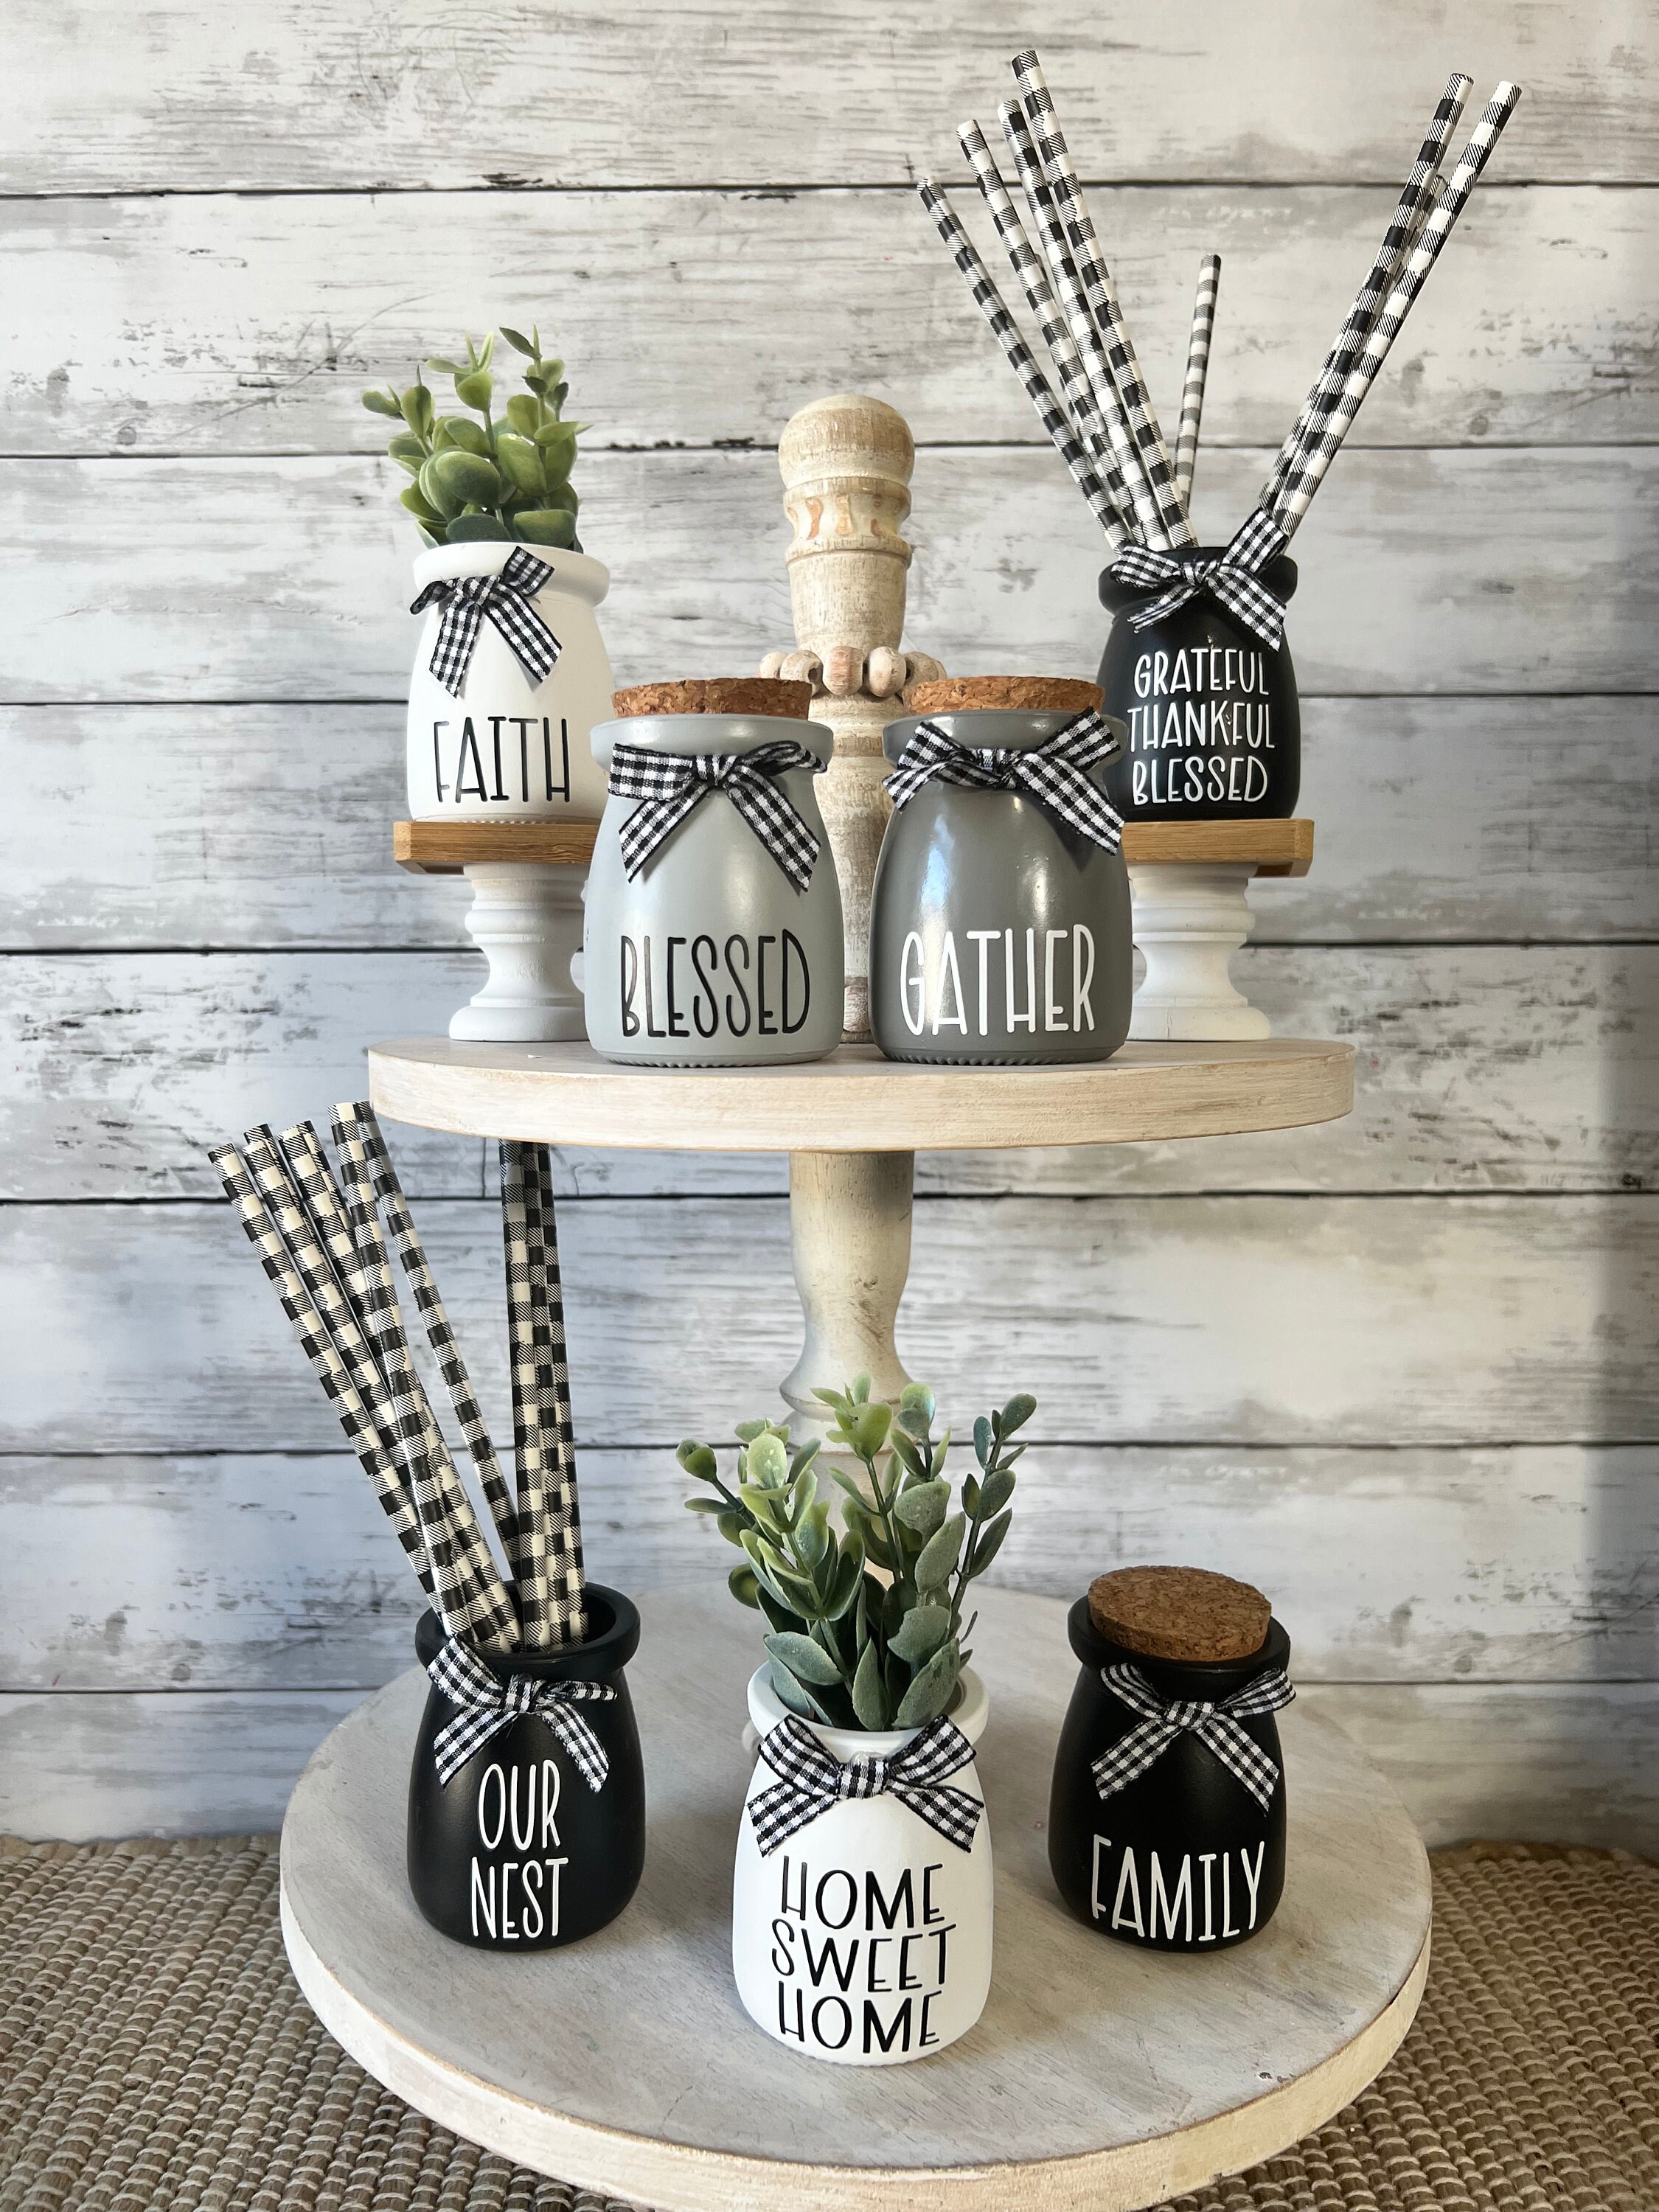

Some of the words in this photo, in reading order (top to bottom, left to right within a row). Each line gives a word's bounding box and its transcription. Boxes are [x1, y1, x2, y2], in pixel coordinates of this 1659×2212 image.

[1134, 648, 1270, 698] GRATEFUL
[434, 716, 571, 804] FAITH
[1127, 700, 1275, 753] THANKFUL
[1132, 755, 1268, 806] BLESSED
[621, 928, 810, 1038] BLESSED
[900, 924, 1096, 1036] GATHER
[479, 1759, 561, 1851] OUR
[471, 1856, 568, 1939] NEST
[782, 1855, 945, 1931] HOME
[1091, 1834, 1265, 1941] FAMILY
[771, 1919, 957, 1992] SWEET
[779, 1980, 942, 2053] HOME
